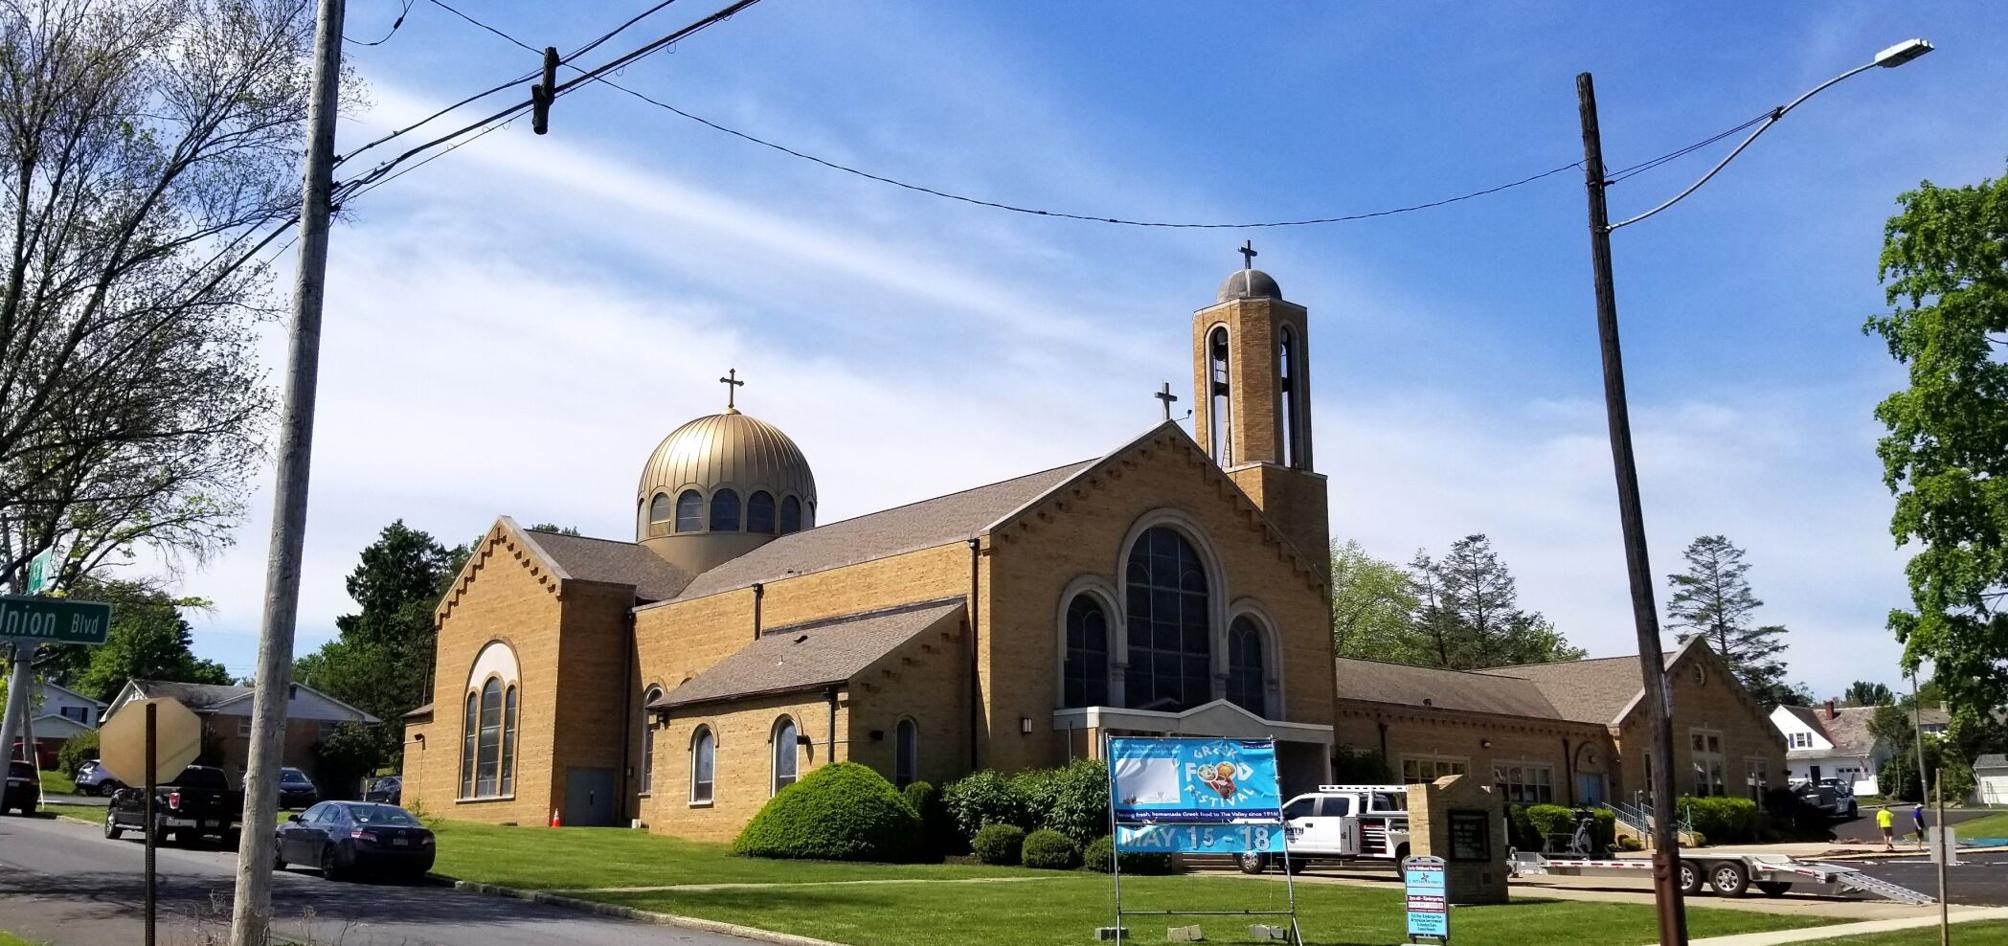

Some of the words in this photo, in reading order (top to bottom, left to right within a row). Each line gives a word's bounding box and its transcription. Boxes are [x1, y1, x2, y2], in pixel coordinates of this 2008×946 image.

[70, 613, 99, 635] Blvd
[1185, 761, 1254, 783] FOOD
[1184, 784, 1255, 808] FESTIVAL
[1121, 828, 1176, 847] MAY
[1187, 826, 1215, 849] 15
[1238, 826, 1270, 851] 18
